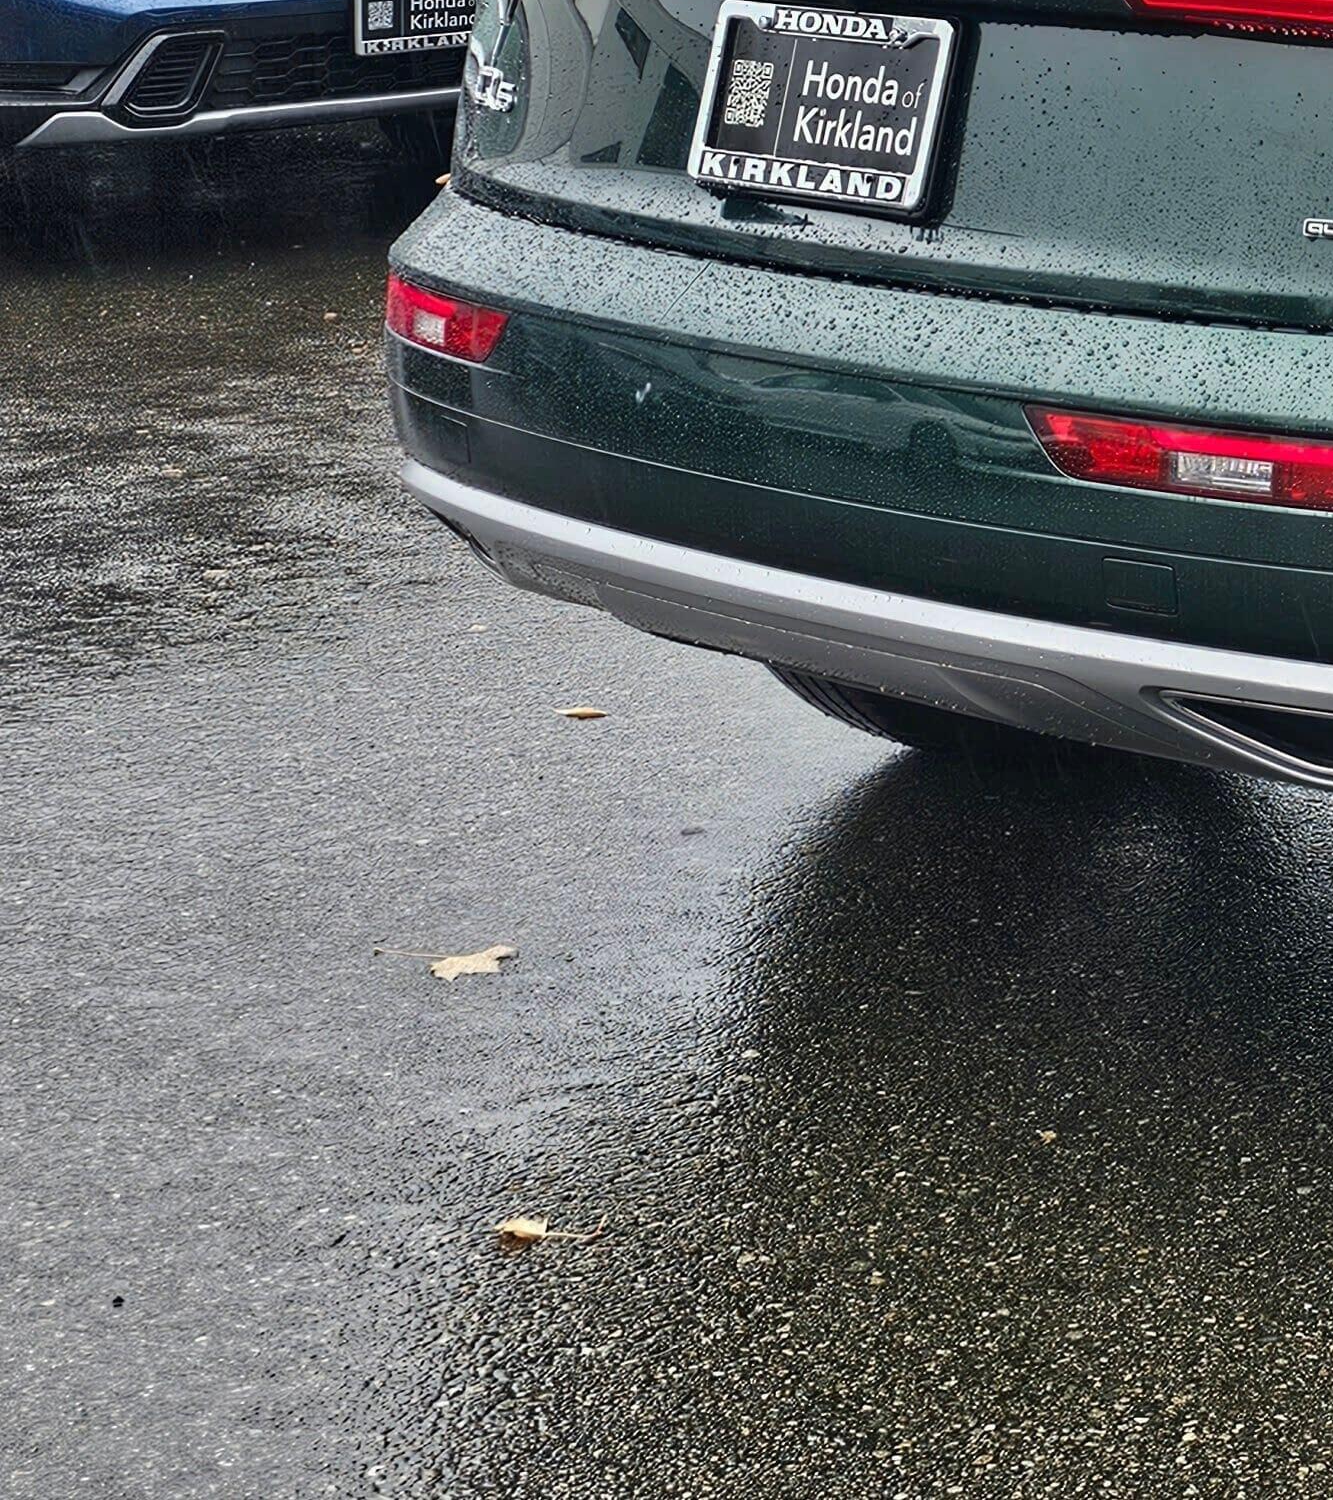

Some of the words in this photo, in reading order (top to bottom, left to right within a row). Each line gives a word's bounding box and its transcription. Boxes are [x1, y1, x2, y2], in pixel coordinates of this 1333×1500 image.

[774, 8, 888, 40] HONDA
[474, 65, 517, 112] Q5
[802, 59, 899, 106] Honda
[901, 82, 924, 109] of
[793, 105, 917, 156] Kirkland
[701, 152, 902, 200] KIRKLAND
